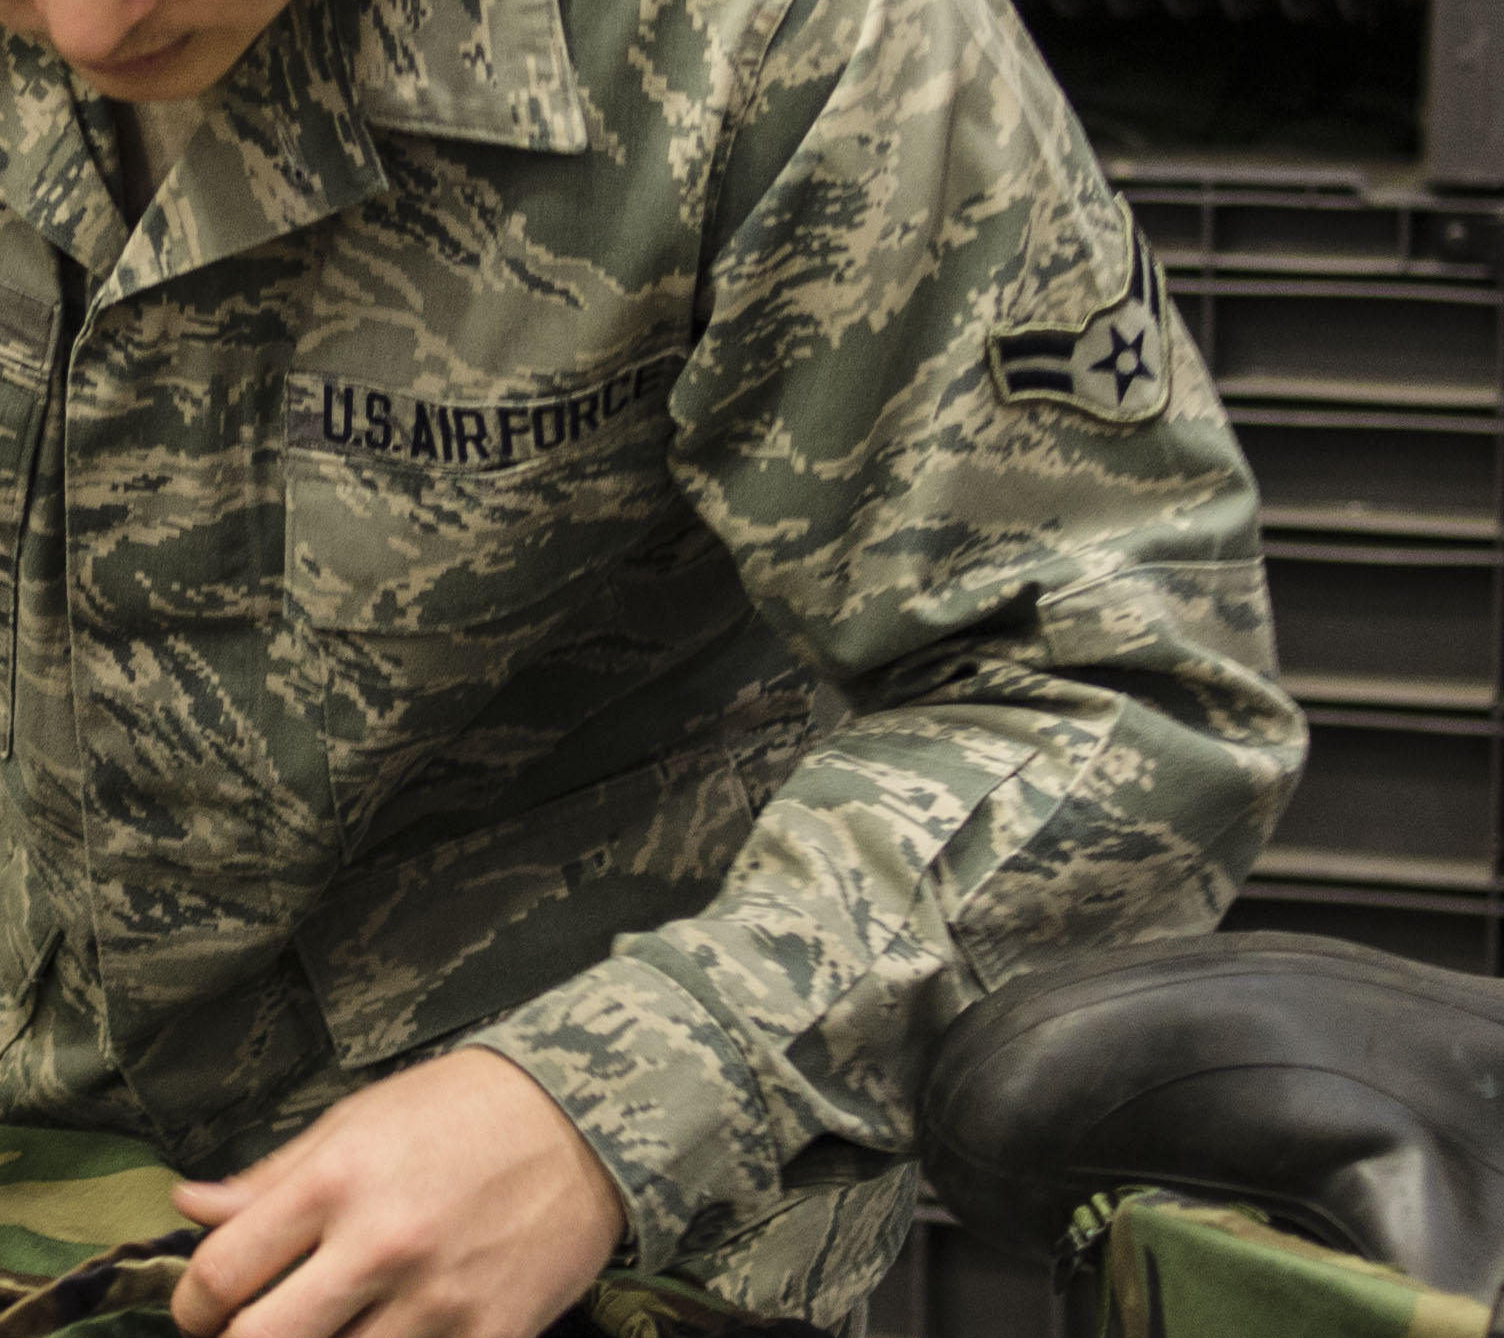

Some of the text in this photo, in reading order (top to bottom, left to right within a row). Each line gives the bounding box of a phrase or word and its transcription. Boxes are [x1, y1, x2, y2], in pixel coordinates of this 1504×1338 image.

[323, 364, 666, 464] U.S. AIR FORCE
